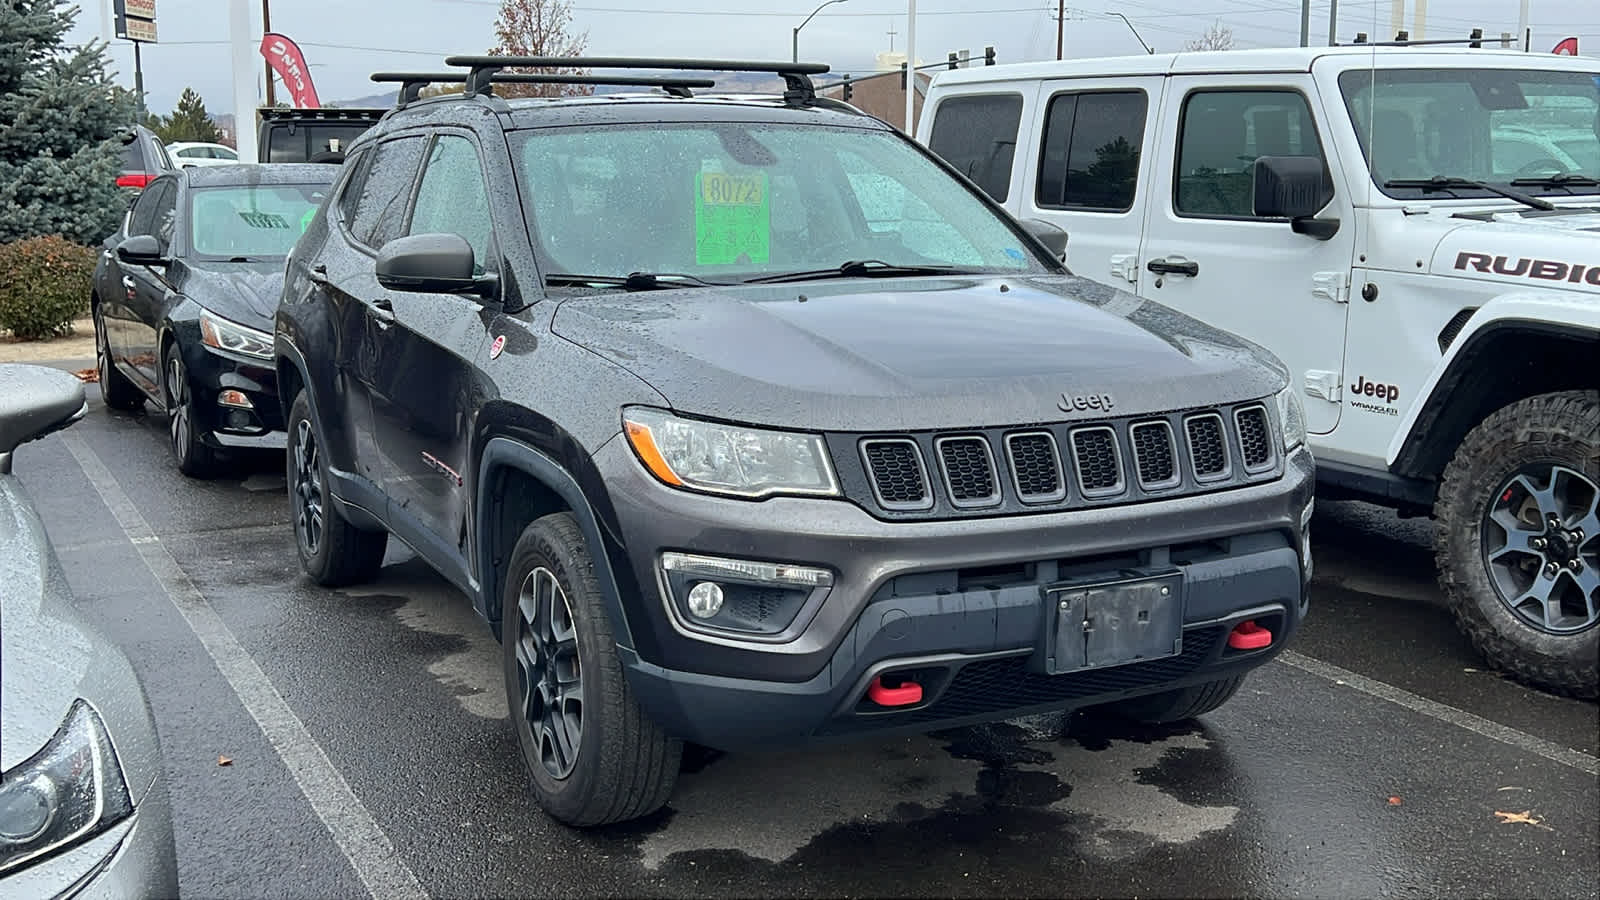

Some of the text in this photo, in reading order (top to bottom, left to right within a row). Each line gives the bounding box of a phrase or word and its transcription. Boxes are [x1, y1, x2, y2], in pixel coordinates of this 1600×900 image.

[711, 177, 754, 201] 8072
[1351, 375, 1399, 403] Jeep
[1056, 393, 1113, 412] Jeep
